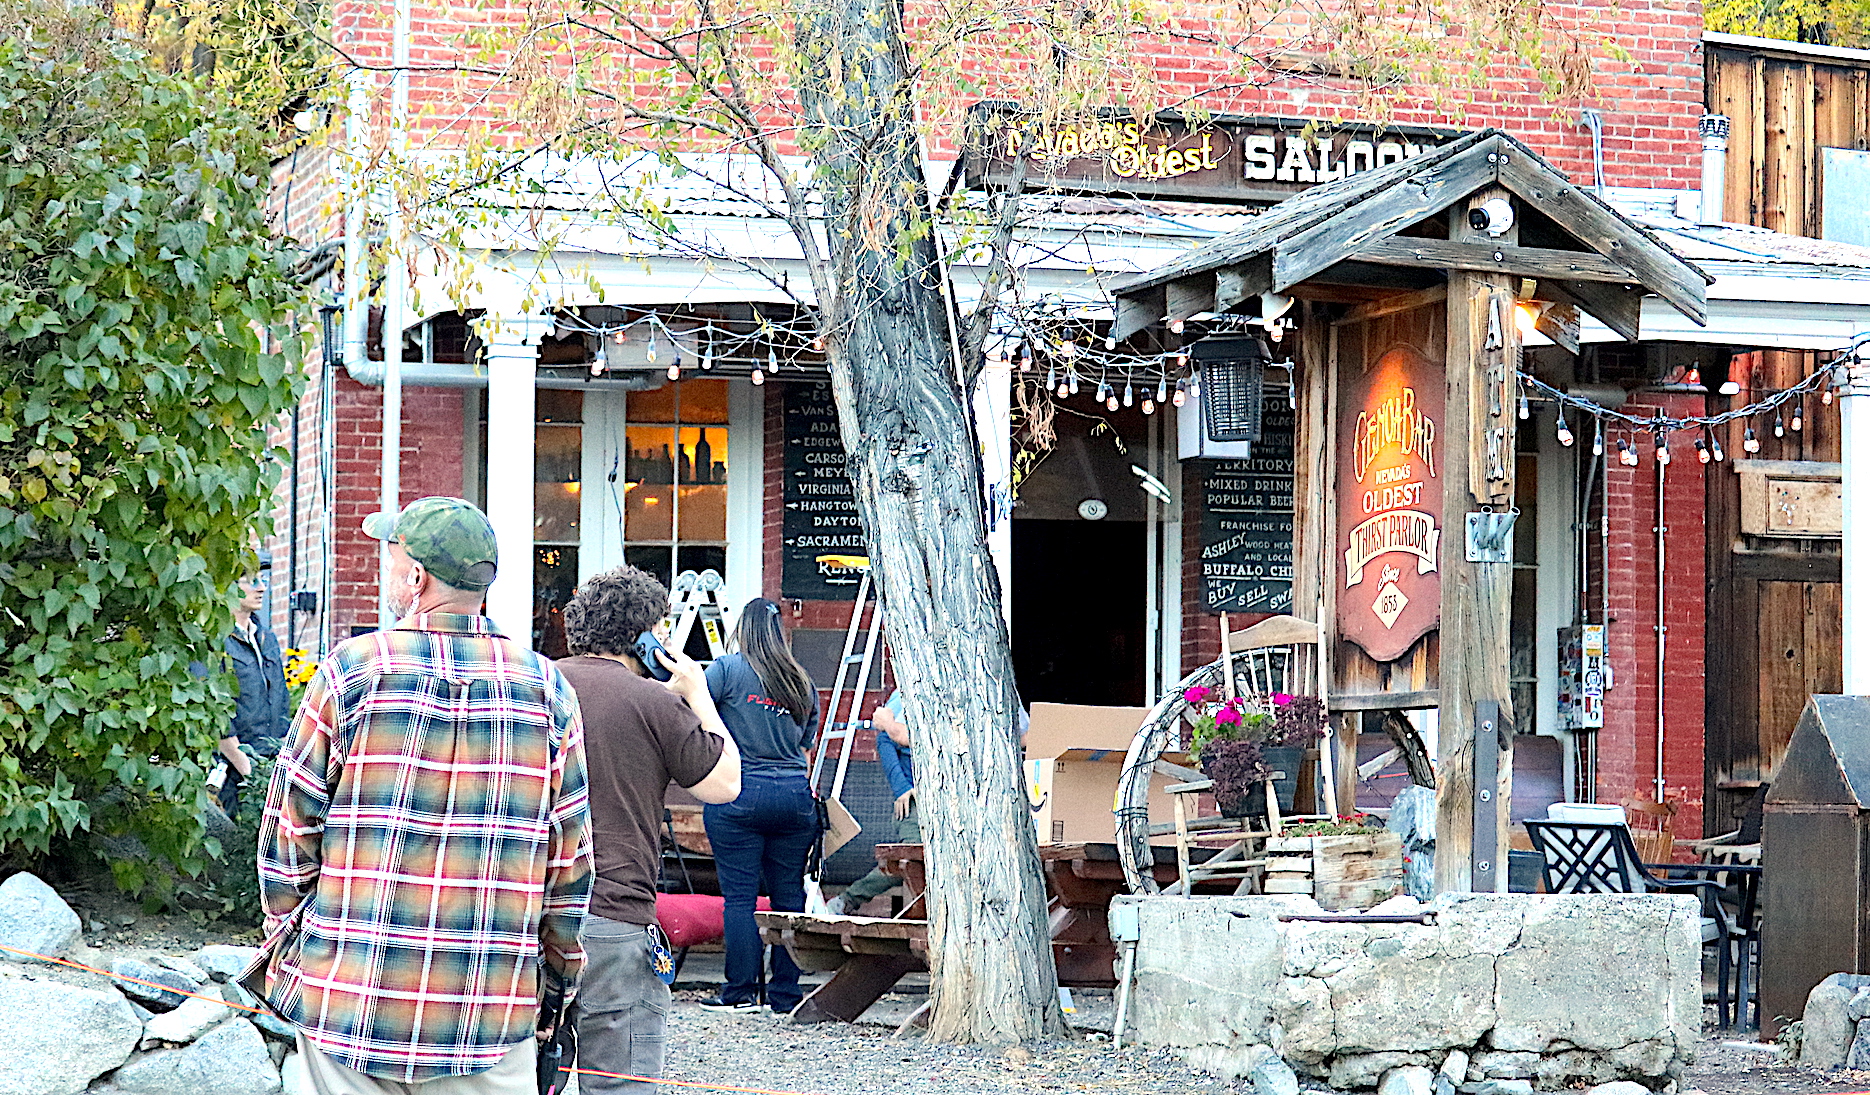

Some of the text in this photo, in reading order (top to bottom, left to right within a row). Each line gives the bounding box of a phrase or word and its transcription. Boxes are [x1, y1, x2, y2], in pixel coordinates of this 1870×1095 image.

[1401, 387, 1436, 477] BAR
[1375, 463, 1411, 485] NEVADA'S
[798, 484, 851, 494] VIRGINIA
[1210, 479, 1248, 490] MIXED
[1208, 494, 1264, 506] POPULAR
[1362, 481, 1424, 514] OLDEST
[1220, 521, 1274, 532] FRANCHISE
[1202, 532, 1246, 558] ASHLEY
[1245, 541, 1270, 549] WOOD
[1355, 515, 1429, 564] THIRST PARLOR
[1268, 554, 1292, 562] LOCAL
[1204, 564, 1264, 576] BUFFALO
[1208, 580, 1222, 588] WE
[1208, 582, 1236, 604] BUY
[1238, 584, 1268, 606] SELL
